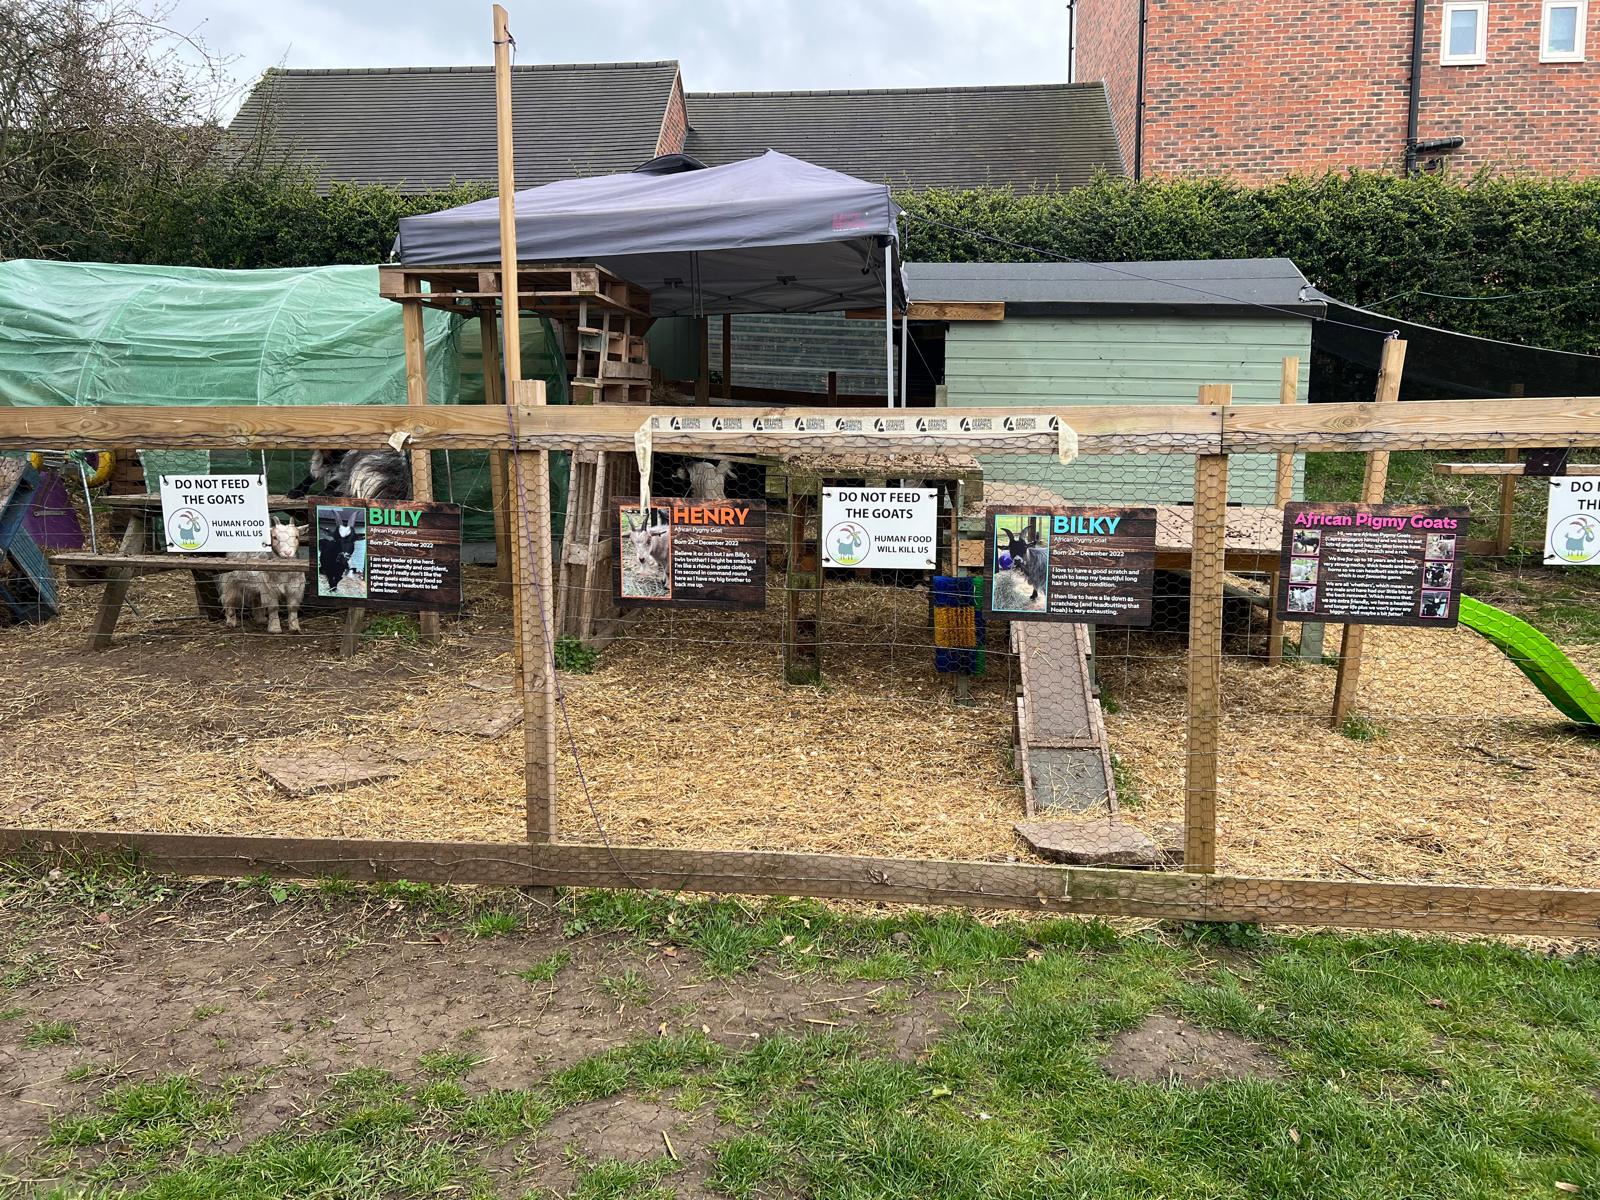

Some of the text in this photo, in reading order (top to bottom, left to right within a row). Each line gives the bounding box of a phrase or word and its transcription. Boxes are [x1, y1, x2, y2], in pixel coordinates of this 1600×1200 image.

[175, 479, 249, 489] DO NOT FEED
[1571, 482, 1593, 492] DO
[183, 495, 244, 504] THE GOATS
[839, 492, 920, 502] DO NOT FEED
[1578, 500, 1600, 510] TH
[369, 508, 422, 527] BILLY
[673, 507, 749, 525] HENRY
[846, 509, 913, 518] THE GOATS
[1054, 515, 1120, 535] BILKY
[1295, 512, 1458, 530] African Pigmy Goats
